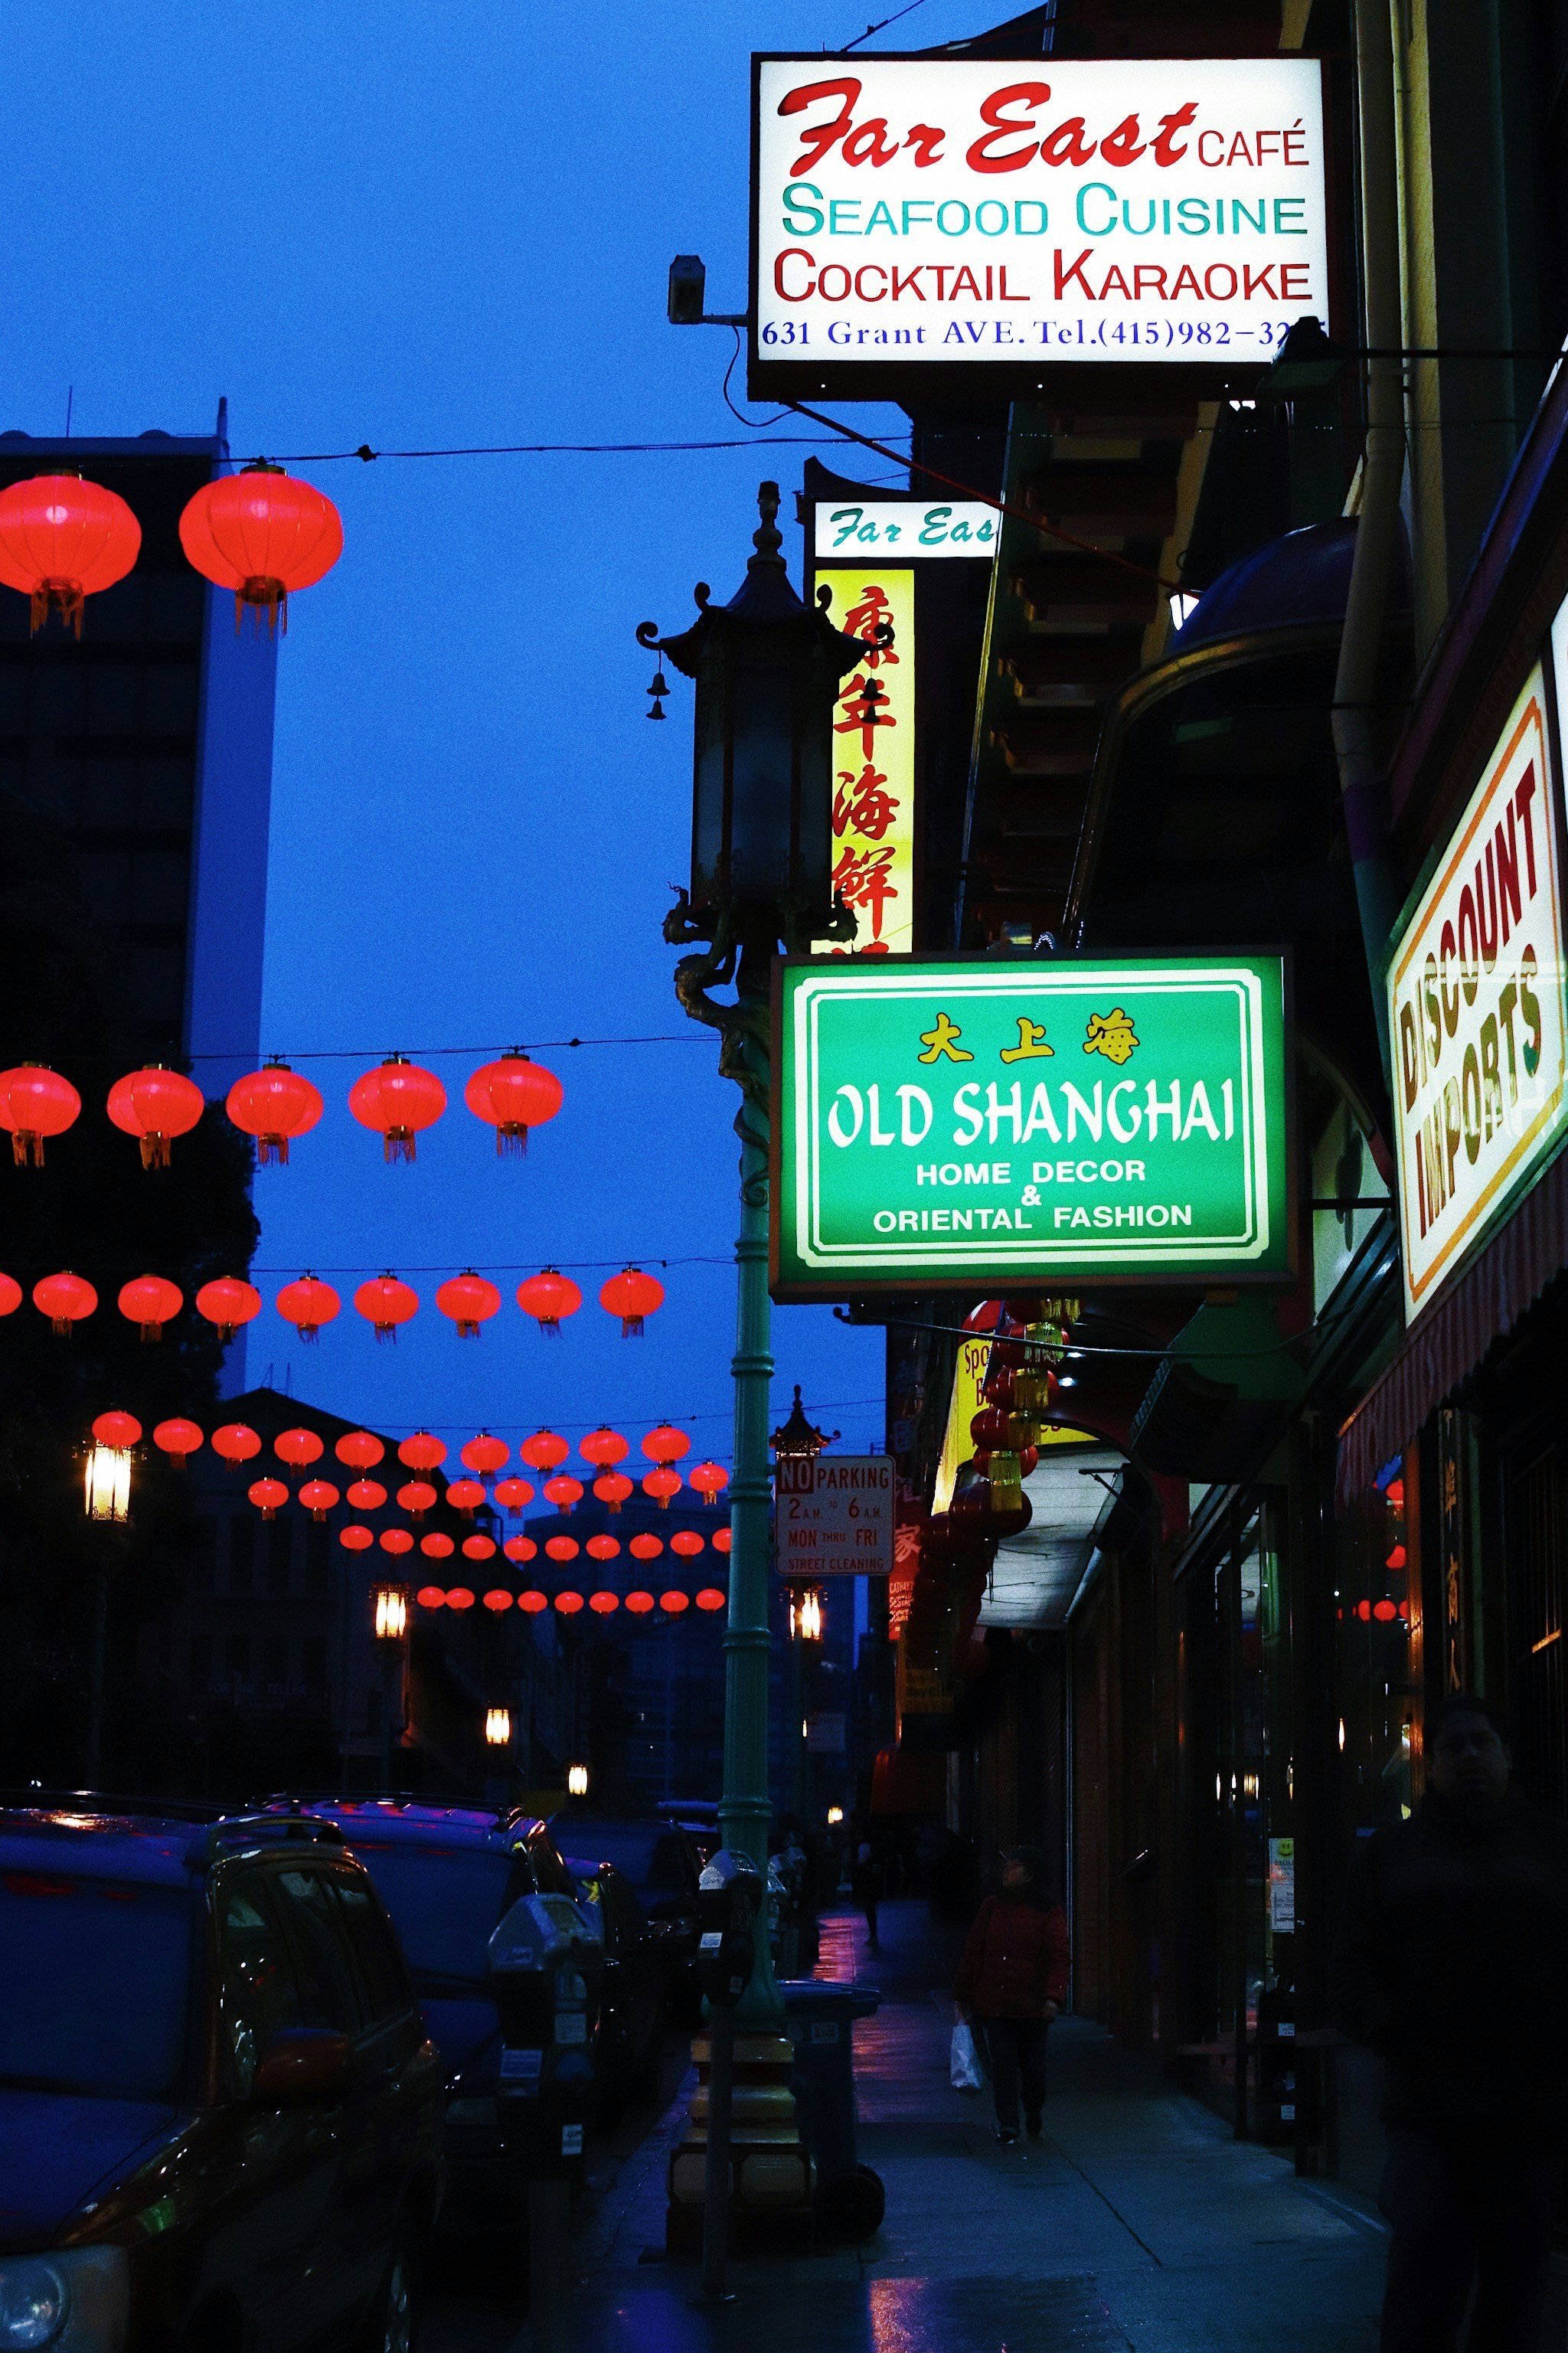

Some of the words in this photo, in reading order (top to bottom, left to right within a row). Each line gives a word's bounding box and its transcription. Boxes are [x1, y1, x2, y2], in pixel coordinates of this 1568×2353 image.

[777, 77, 946, 178] Far
[965, 81, 1200, 174] East
[1197, 119, 1309, 167] CAFÉ
[781, 182, 1048, 236] SEAFOOD
[1076, 182, 1308, 236] CUISINE
[773, 248, 1031, 302] COCKTAIL
[1053, 248, 1313, 301] KARAOKE
[762, 321, 810, 345] 631
[828, 321, 926, 345] Grant
[942, 321, 1025, 345] AVE.
[830, 508, 902, 547] Far
[918, 507, 998, 545] Eas
[1400, 757, 1537, 1115] DISCOUNT
[917, 1007, 1140, 1065] 大上海
[1416, 943, 1541, 1240] IMPORTS
[828, 1083, 933, 1148] OLD
[952, 1078, 1233, 1146] SHANGHAI
[916, 1162, 1011, 1185] HOME
[1032, 1159, 1146, 1183] DECOR
[1021, 1184, 1042, 1206] &
[873, 1208, 1032, 1232] ORIENTAL
[1054, 1204, 1192, 1227] FASHION
[964, 1342, 991, 1379] Spo
[781, 1459, 812, 1489] NO
[818, 1467, 889, 1489] PARKING
[789, 1498, 800, 1519] 2
[849, 1498, 859, 1518] 6
[789, 1530, 817, 1547] MON
[822, 1533, 846, 1543] THRU
[856, 1529, 877, 1547] FRI
[789, 1558, 826, 1570] STREET
[830, 1558, 884, 1569] CLEANING
[207, 1682, 257, 1694] FORNE
